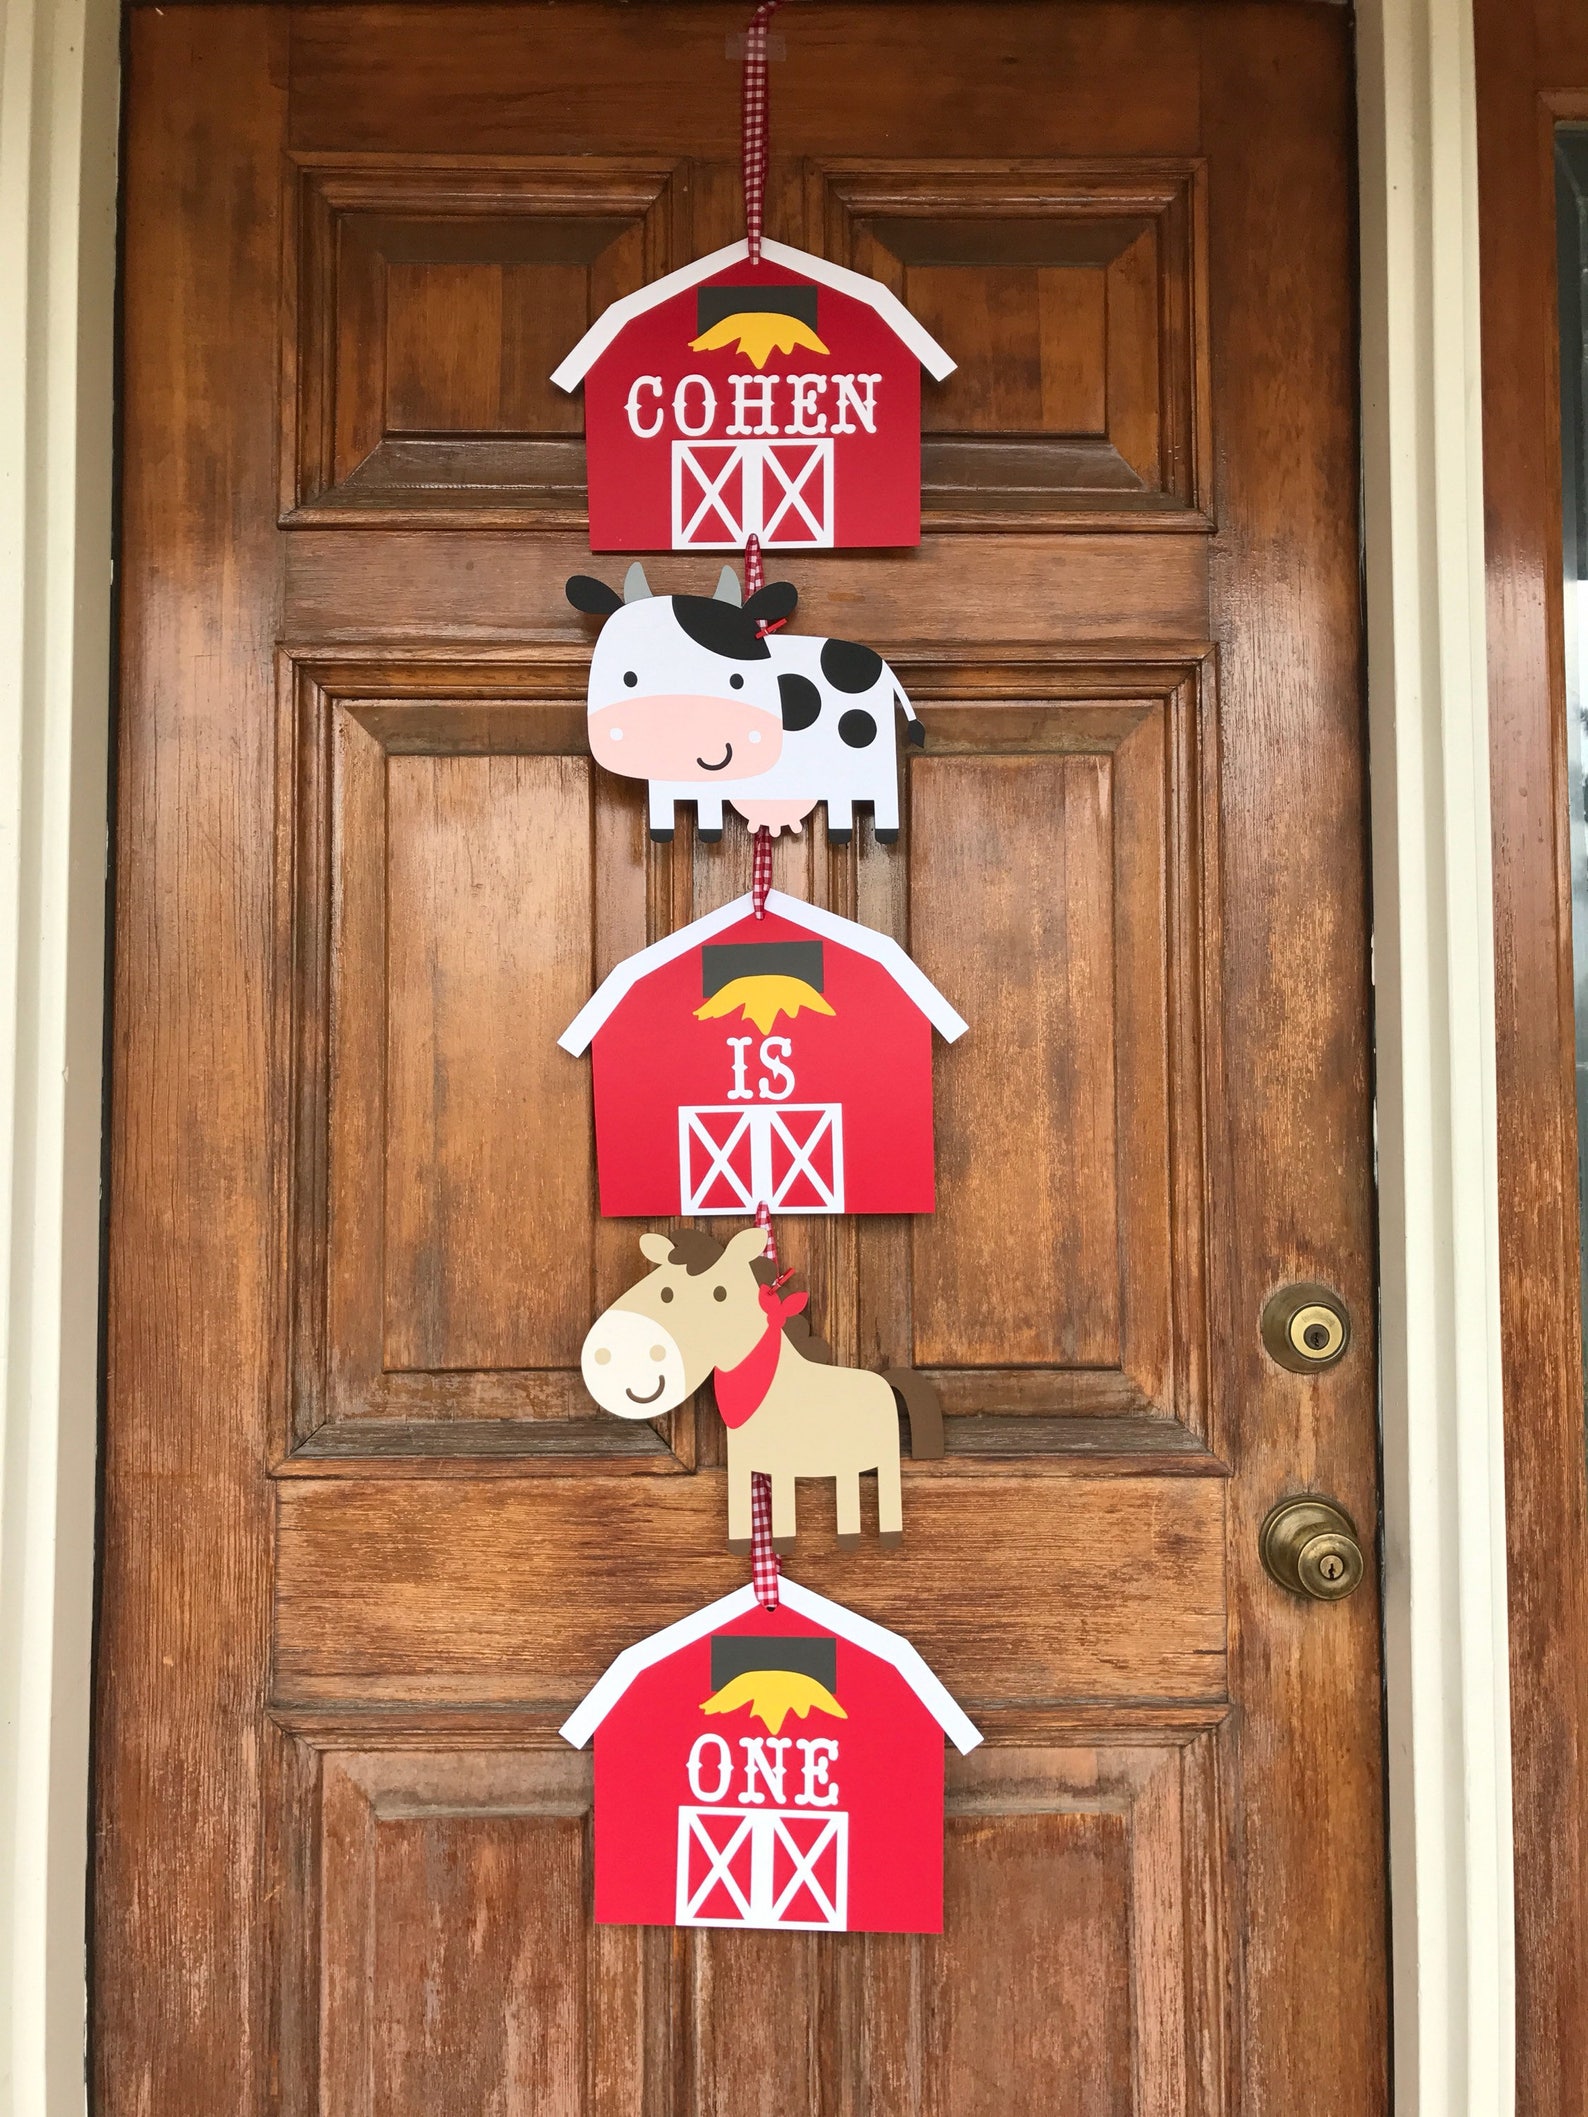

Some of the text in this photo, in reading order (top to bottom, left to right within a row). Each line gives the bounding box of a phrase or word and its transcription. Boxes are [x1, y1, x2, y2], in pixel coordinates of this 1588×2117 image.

[624, 374, 882, 438] COHEN
[726, 1036, 796, 1101] IS
[686, 1733, 840, 1807] ONE
